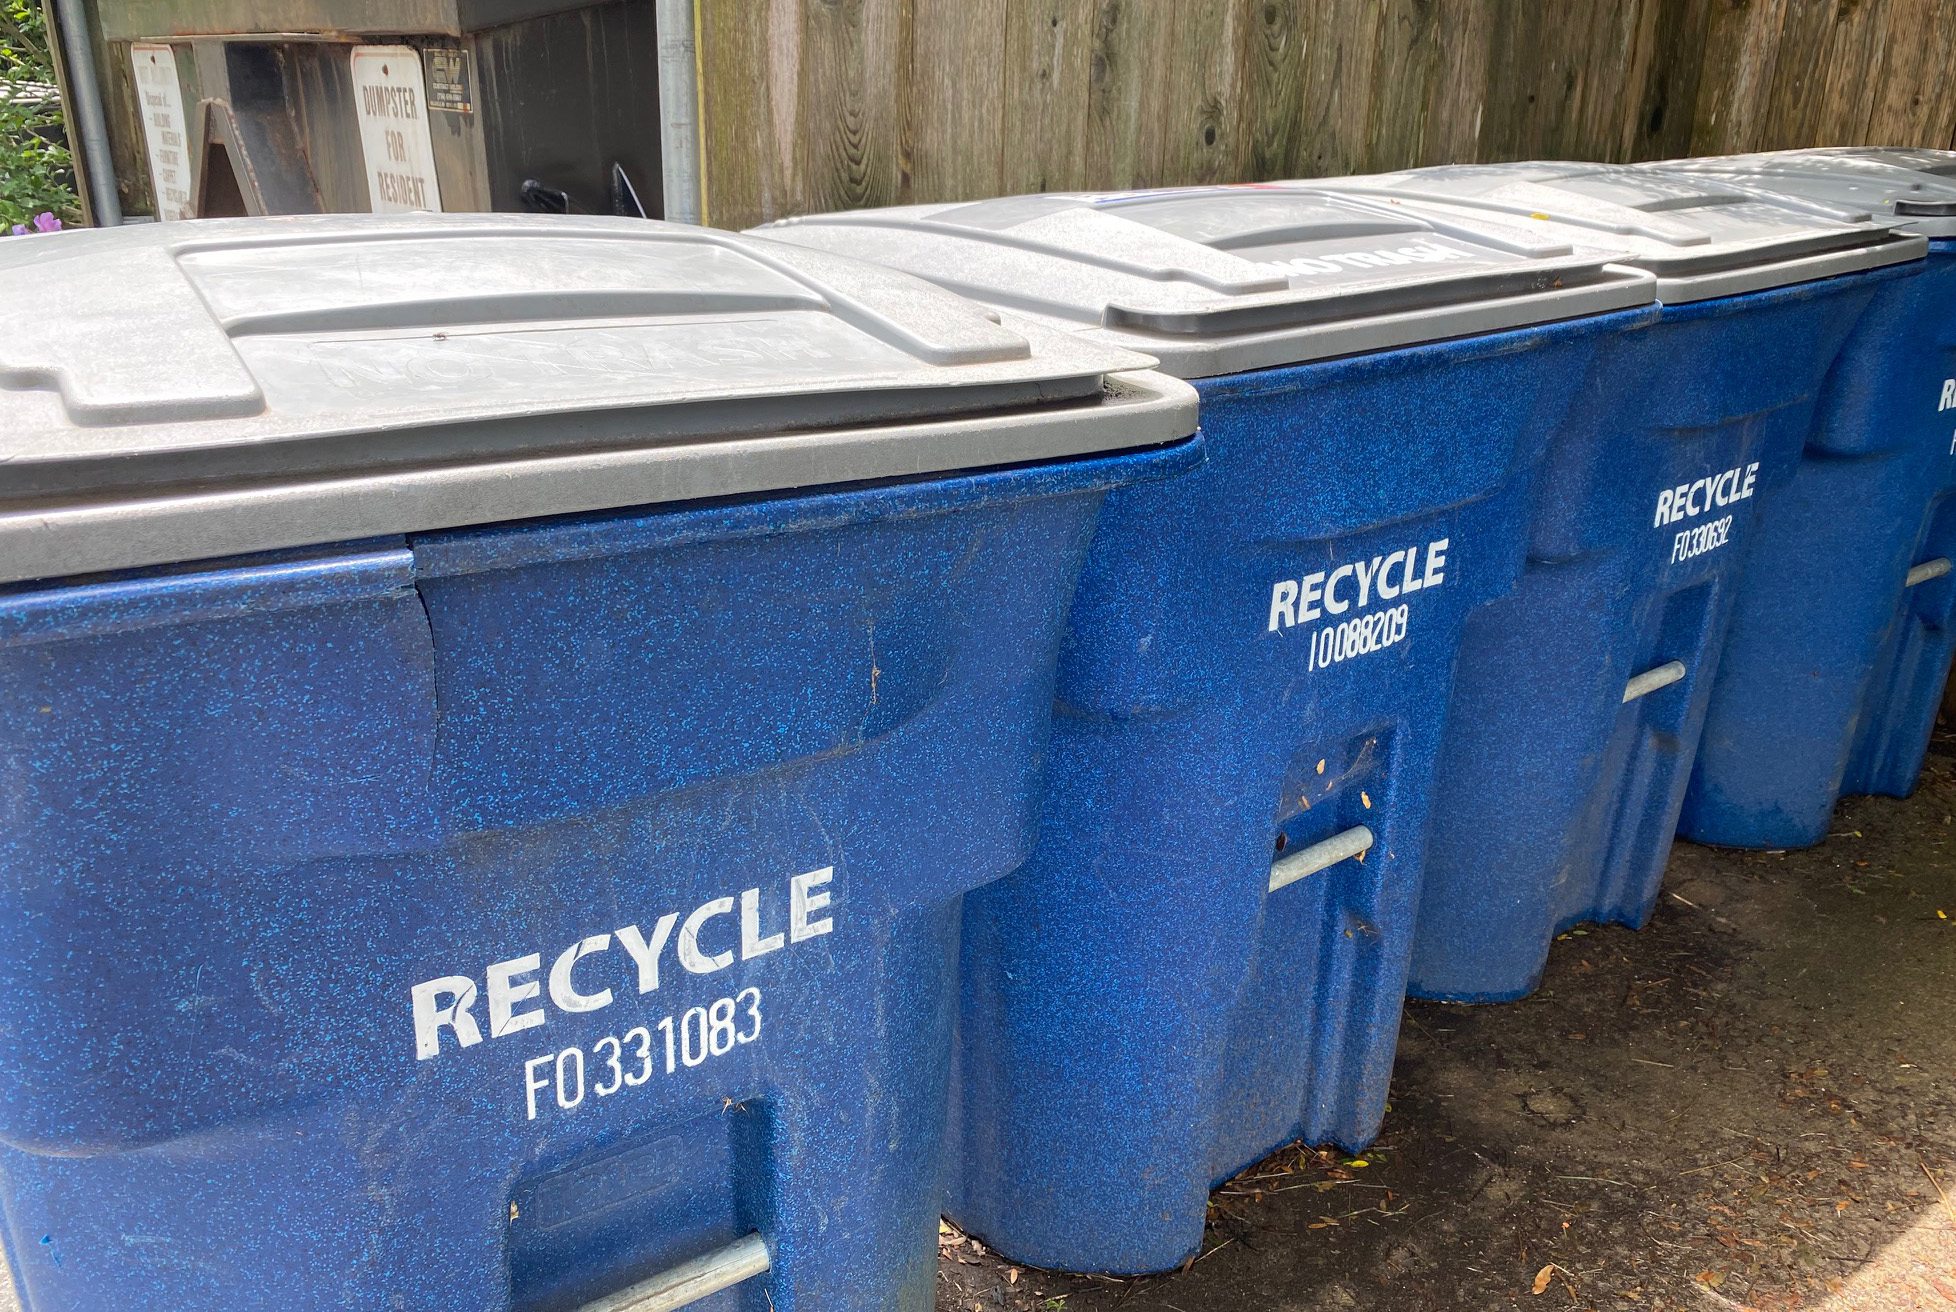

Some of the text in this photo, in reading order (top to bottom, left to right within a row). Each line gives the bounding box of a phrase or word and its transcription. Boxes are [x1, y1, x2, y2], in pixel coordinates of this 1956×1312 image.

[362, 85, 418, 120] DUMPSTER
[385, 130, 406, 163] FOR
[377, 170, 427, 209] RESIDENT
[1257, 239, 1477, 277] NO TRASH
[1653, 461, 1760, 529] RECYCLE
[1268, 537, 1449, 632] RECYCLE
[411, 866, 834, 1061] RECYCLE
